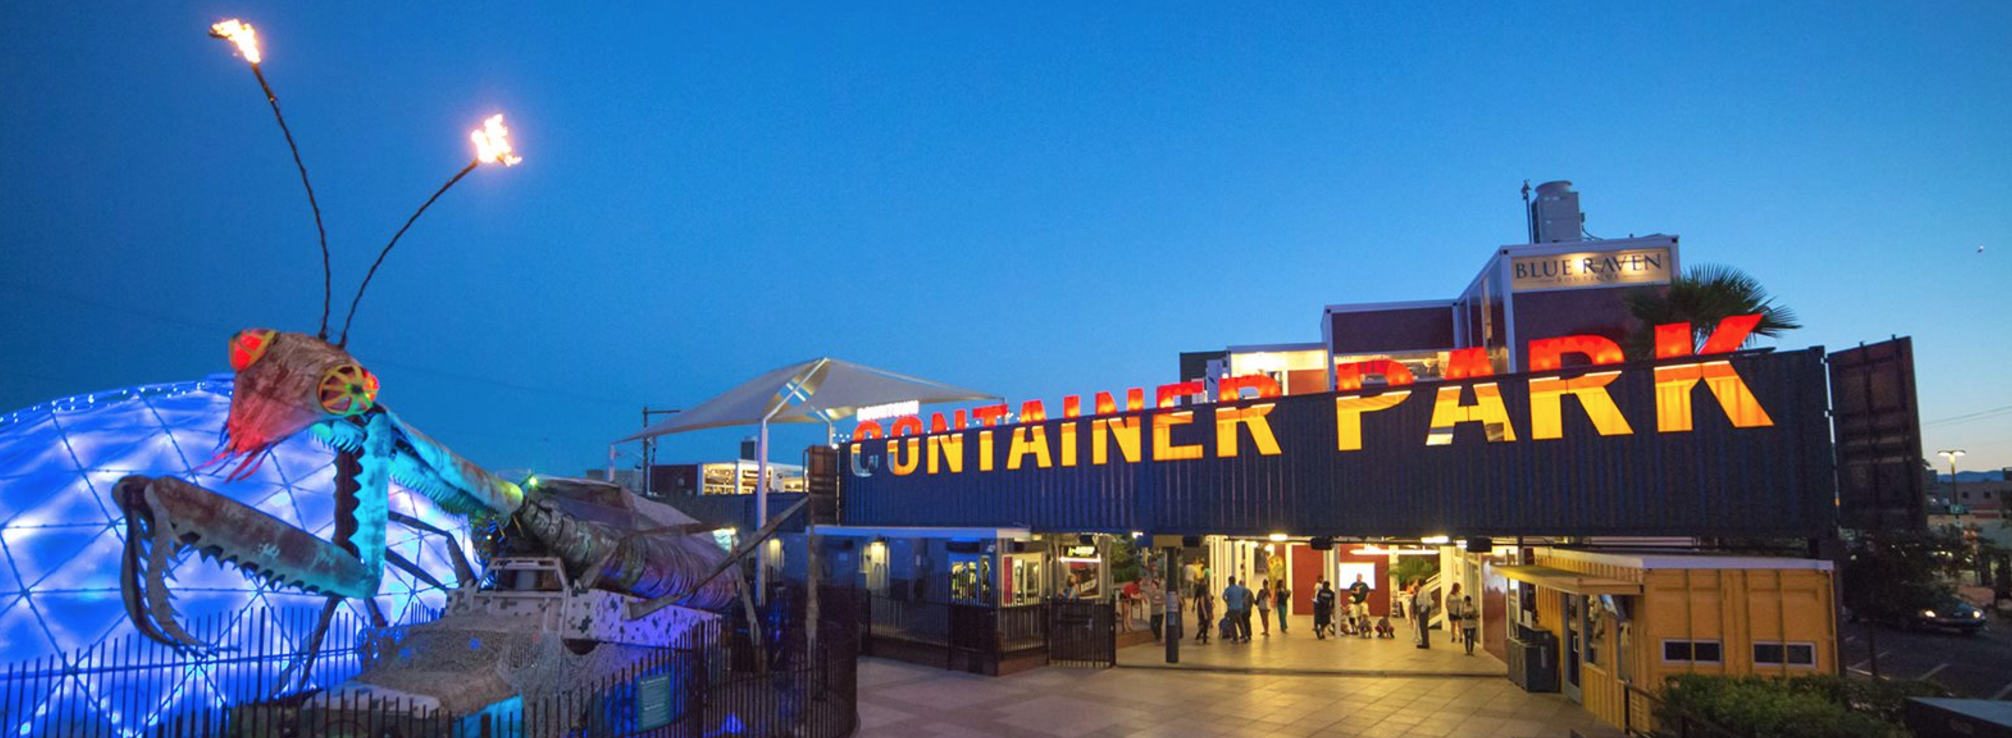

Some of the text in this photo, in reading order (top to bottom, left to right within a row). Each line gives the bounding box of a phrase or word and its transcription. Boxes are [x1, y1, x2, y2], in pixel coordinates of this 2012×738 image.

[1515, 253, 1662, 279] BLUE RAVEN
[850, 314, 1774, 477] CONTAINER PARK
